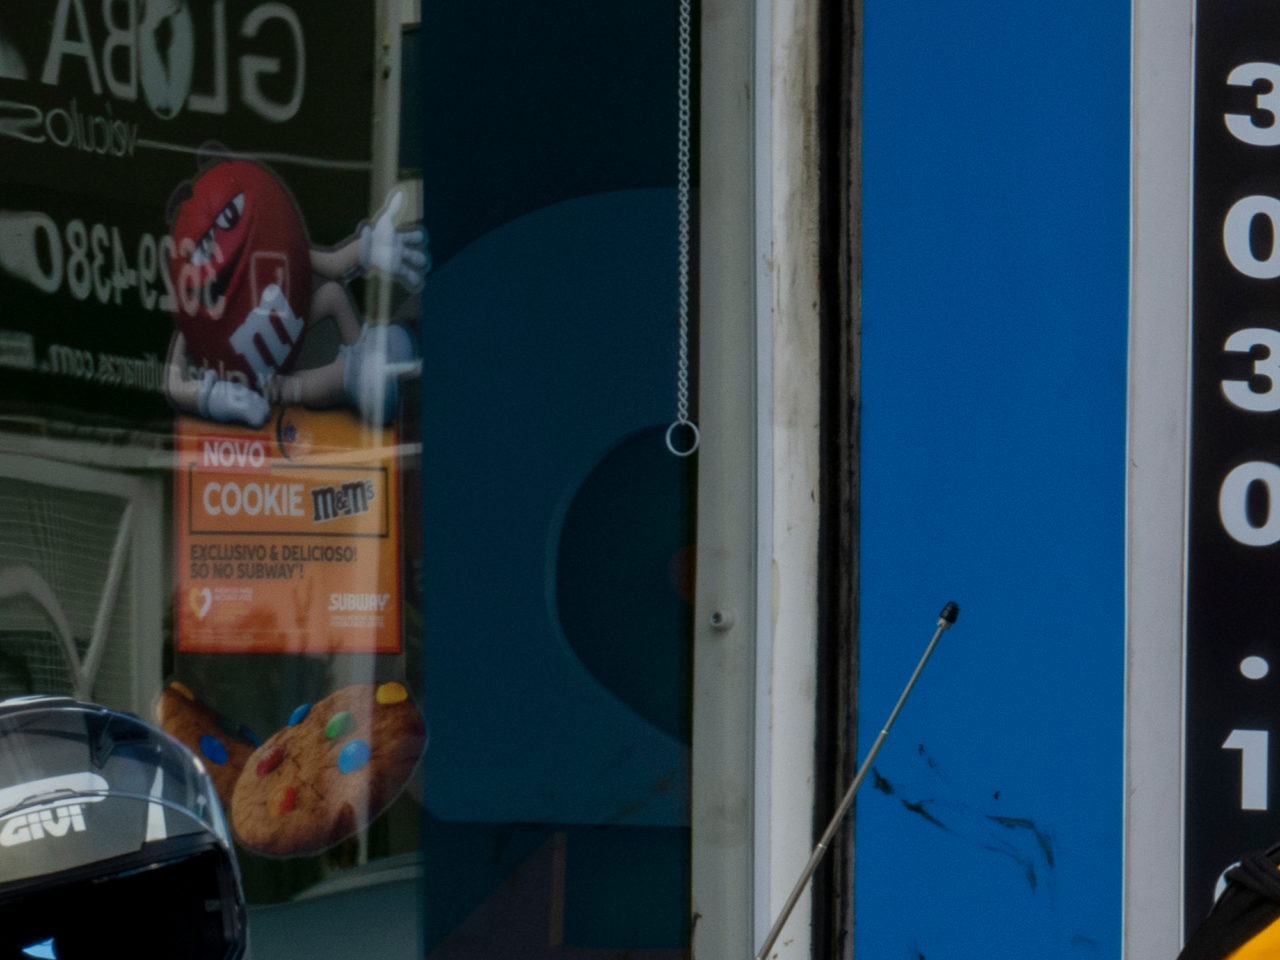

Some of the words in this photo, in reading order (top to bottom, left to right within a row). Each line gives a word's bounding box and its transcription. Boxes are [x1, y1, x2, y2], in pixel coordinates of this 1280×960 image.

[203, 441, 266, 468] NOVO
[202, 481, 305, 517] COOKIE
[190, 544, 267, 562] EXCLUSIVO
[270, 545, 280, 562] &
[282, 545, 358, 563] DELICIOSO!
[212, 563, 233, 580] NO
[328, 593, 391, 612] SUBWAY
[0, 804, 86, 847] GIVI
